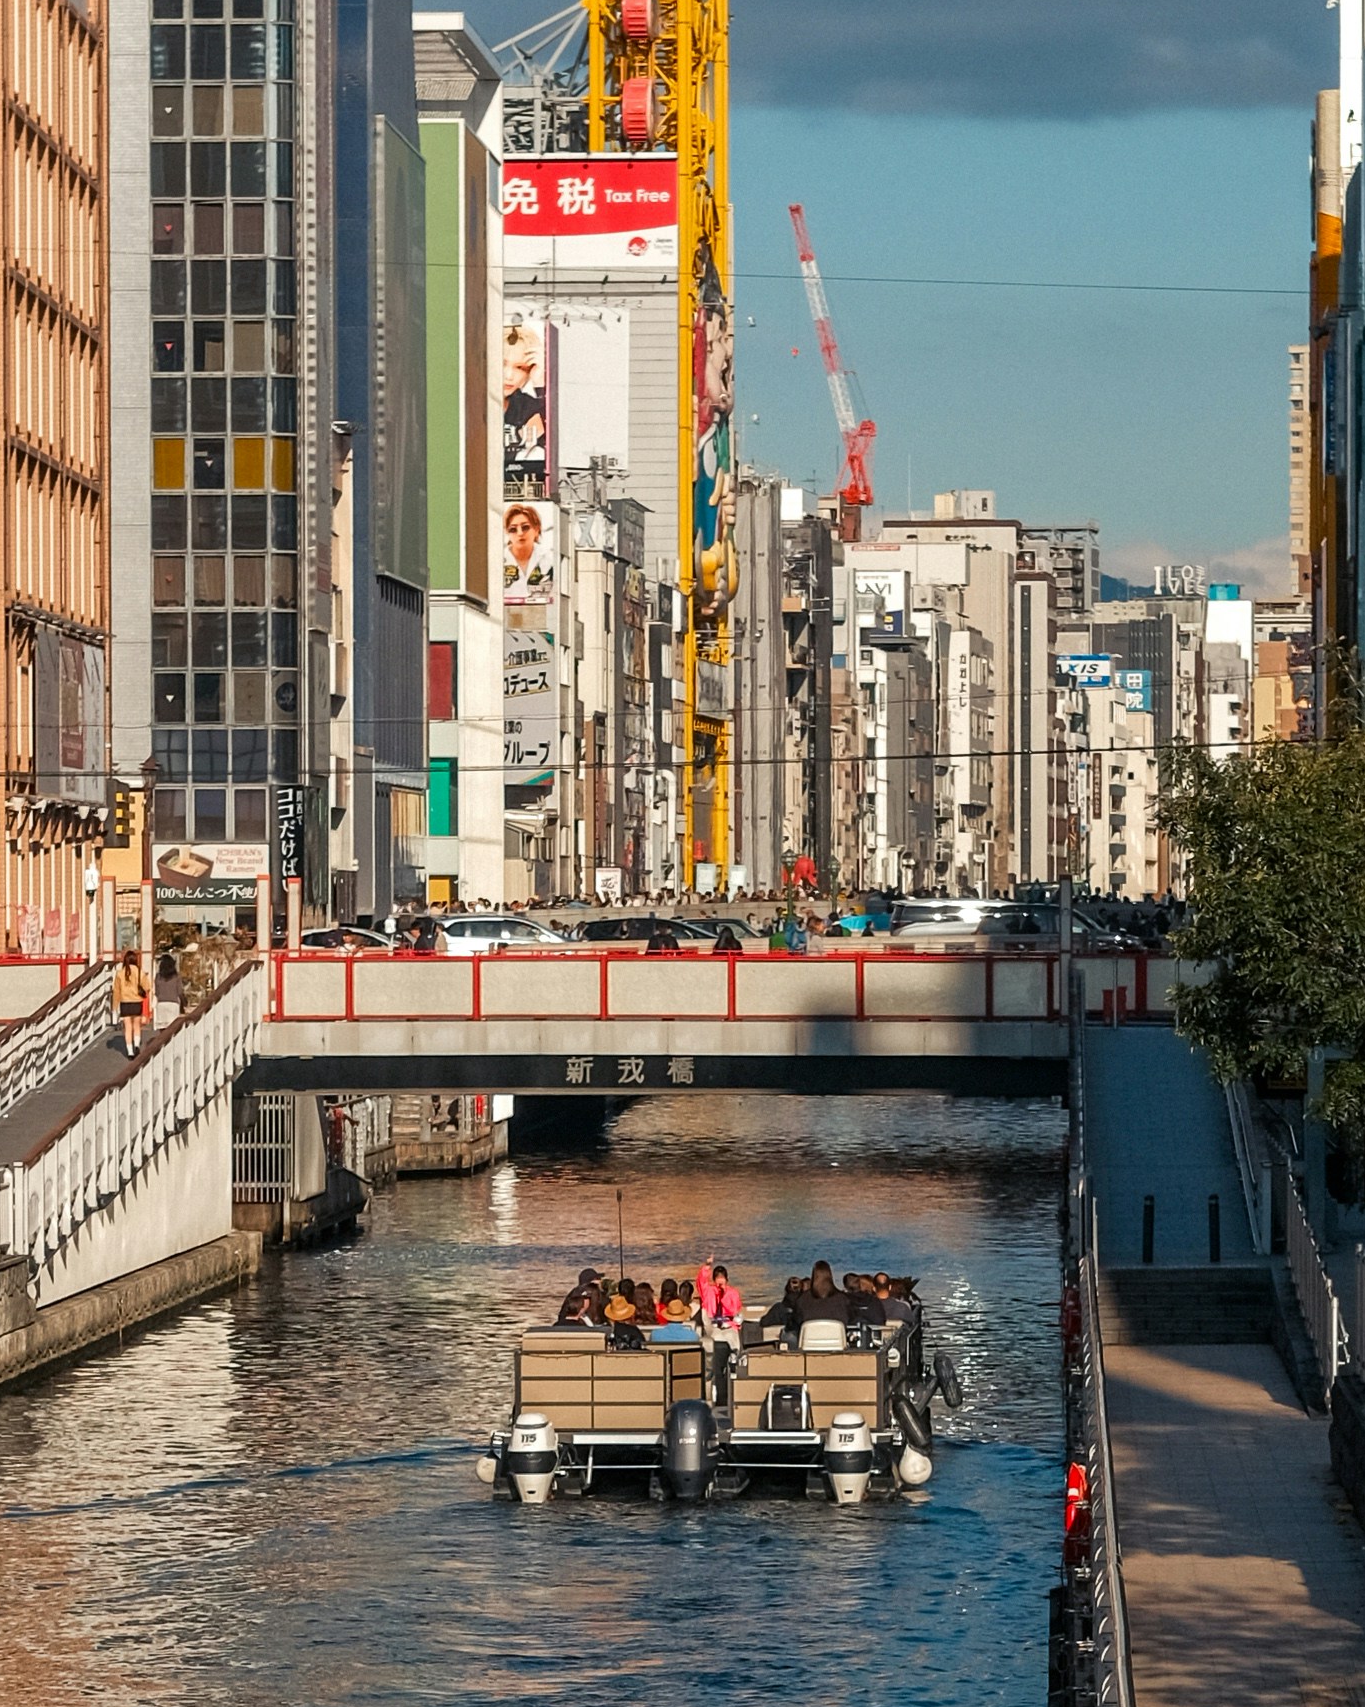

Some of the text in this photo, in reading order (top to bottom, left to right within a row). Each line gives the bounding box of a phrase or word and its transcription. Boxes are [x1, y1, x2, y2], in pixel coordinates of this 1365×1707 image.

[503, 177, 597, 216] 免税
[604, 189, 671, 203] Tax Free
[155, 884, 257, 900] 100%とんこつ不使
[566, 1056, 695, 1084] 新戎橋
[521, 1434, 537, 1443] 115
[838, 1434, 854, 1443] 115
